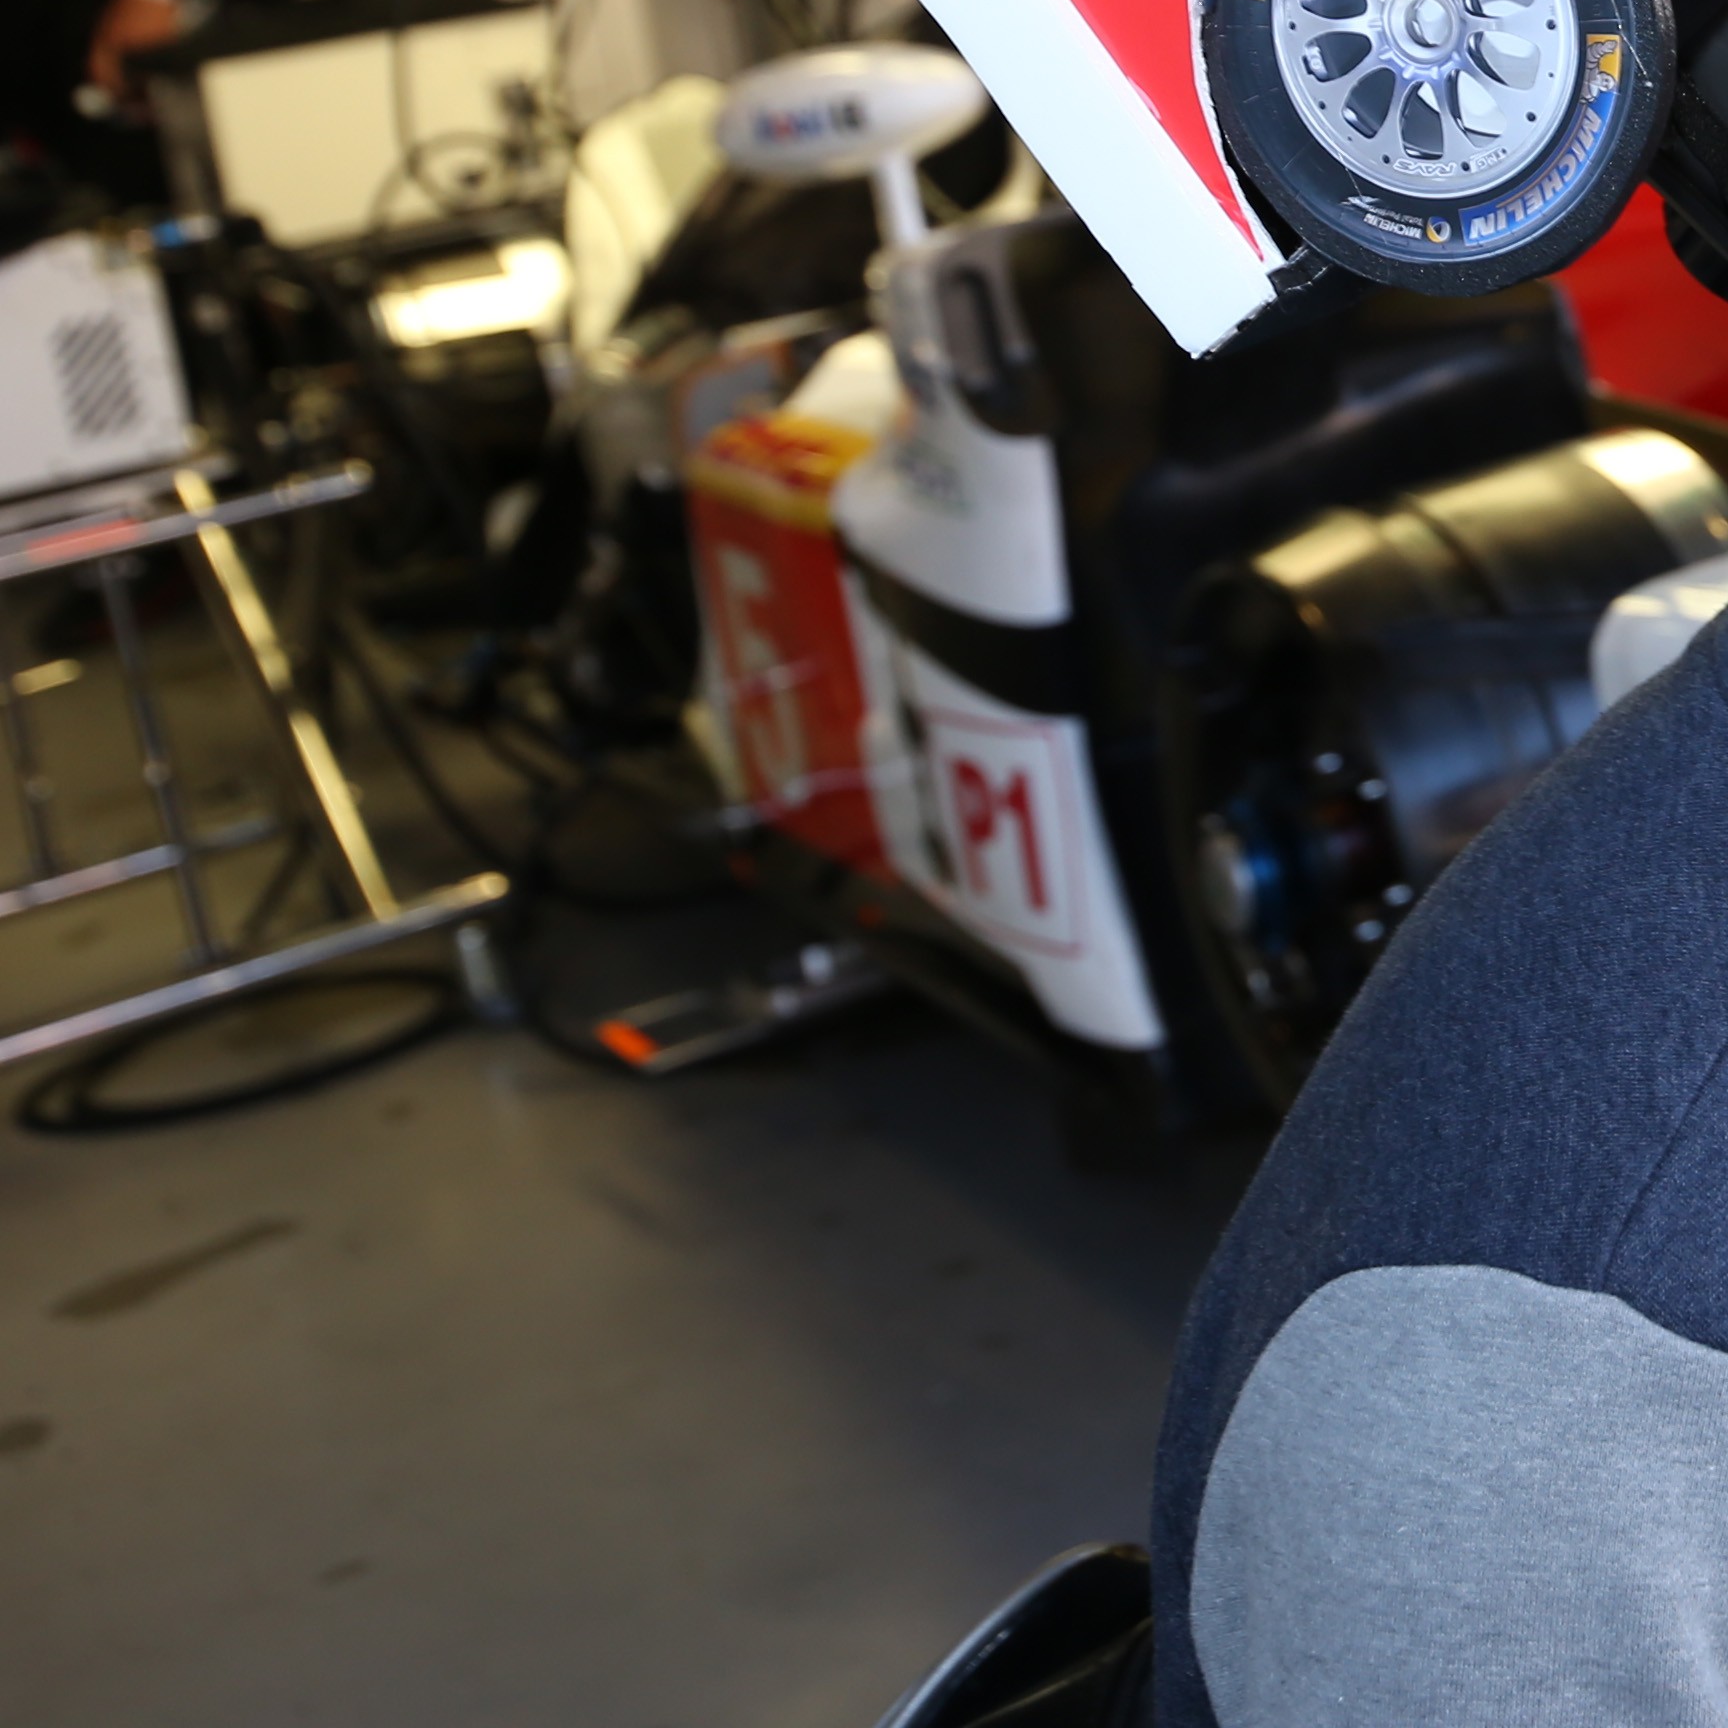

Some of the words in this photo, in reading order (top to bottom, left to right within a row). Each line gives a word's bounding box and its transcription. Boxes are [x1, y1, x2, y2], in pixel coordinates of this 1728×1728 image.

[1393, 159, 1457, 177] RAYS
[1469, 112, 1601, 240] MICHELIN
[1364, 213, 1422, 239] MICHELIN
[946, 756, 1050, 918] P1
